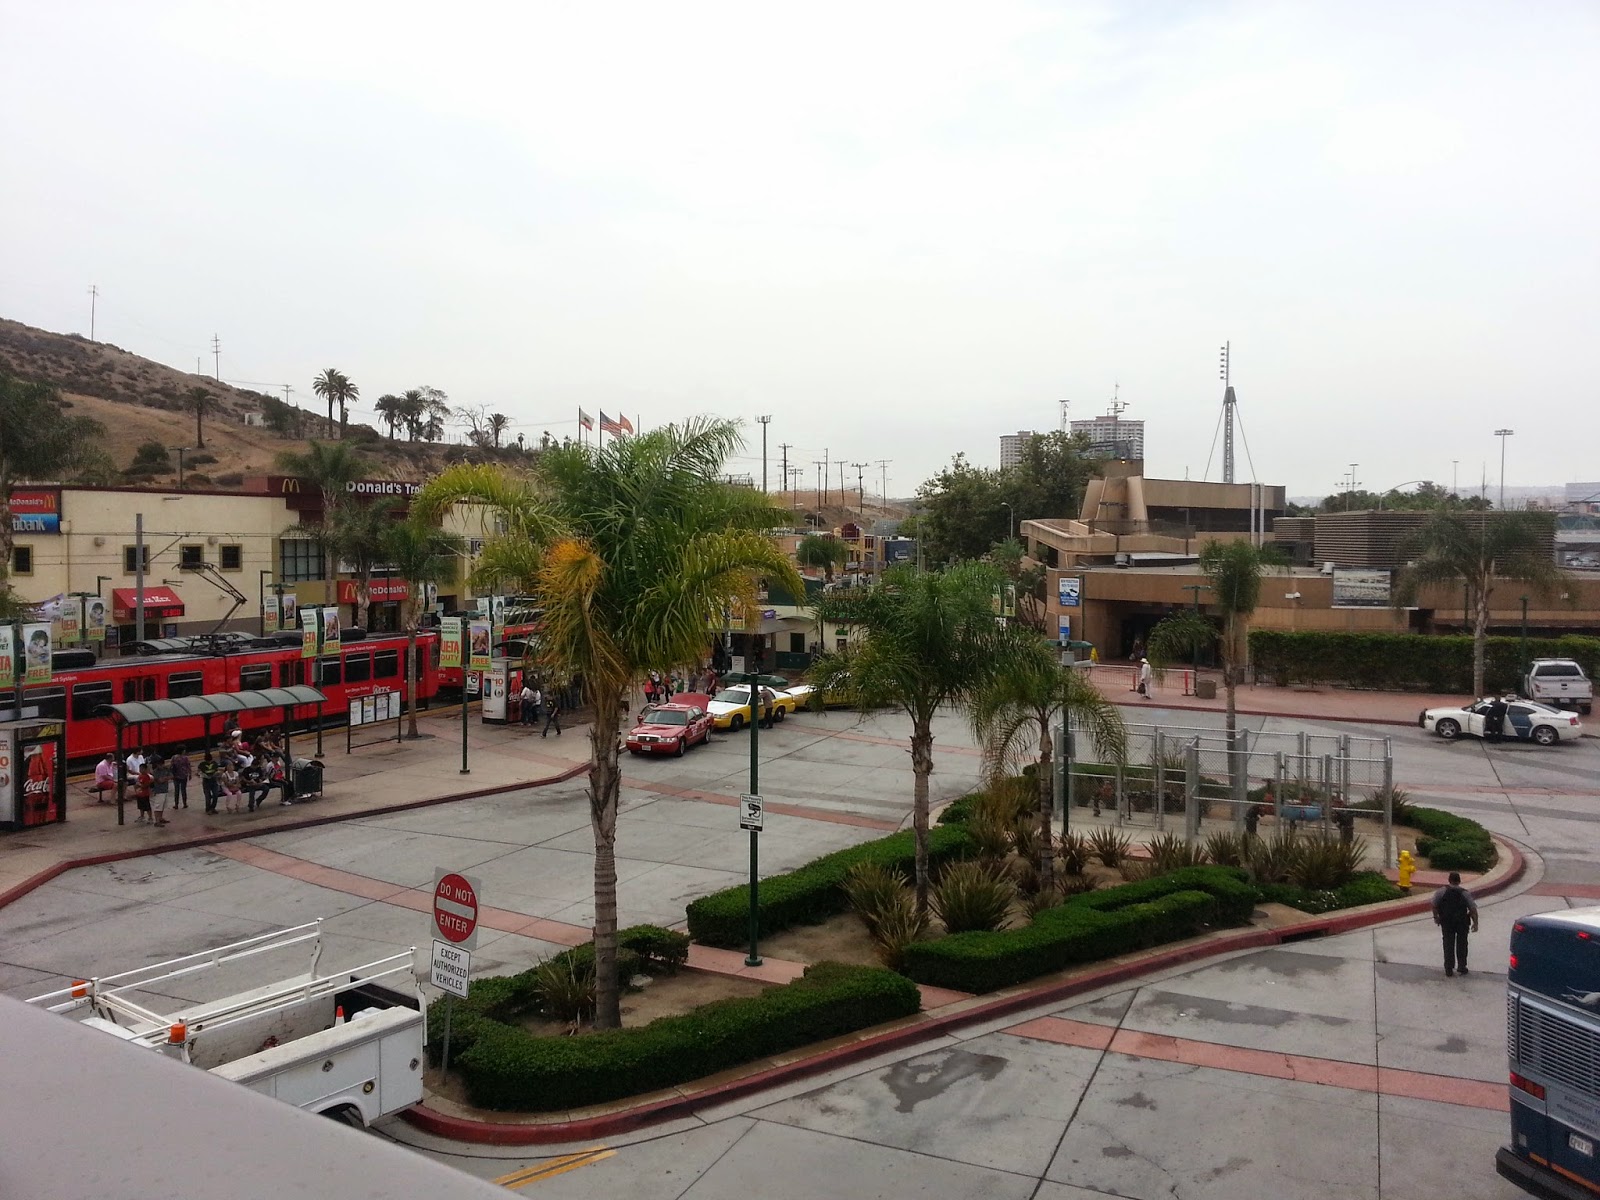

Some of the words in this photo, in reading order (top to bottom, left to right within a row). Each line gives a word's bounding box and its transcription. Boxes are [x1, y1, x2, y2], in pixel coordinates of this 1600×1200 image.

[345, 481, 402, 494] Donald's
[12, 517, 46, 531] tibank
[304, 632, 315, 643] ETA
[0, 655, 12, 671] TA
[0, 672, 11, 680] TY
[28, 669, 49, 677] FREE
[440, 882, 451, 896] DO
[455, 888, 472, 903] NOT
[440, 914, 468, 933] ENTER
[441, 948, 461, 963] EXCEPT
[433, 959, 467, 978] AUTHORIZED
[436, 972, 463, 991] VEHICLES
